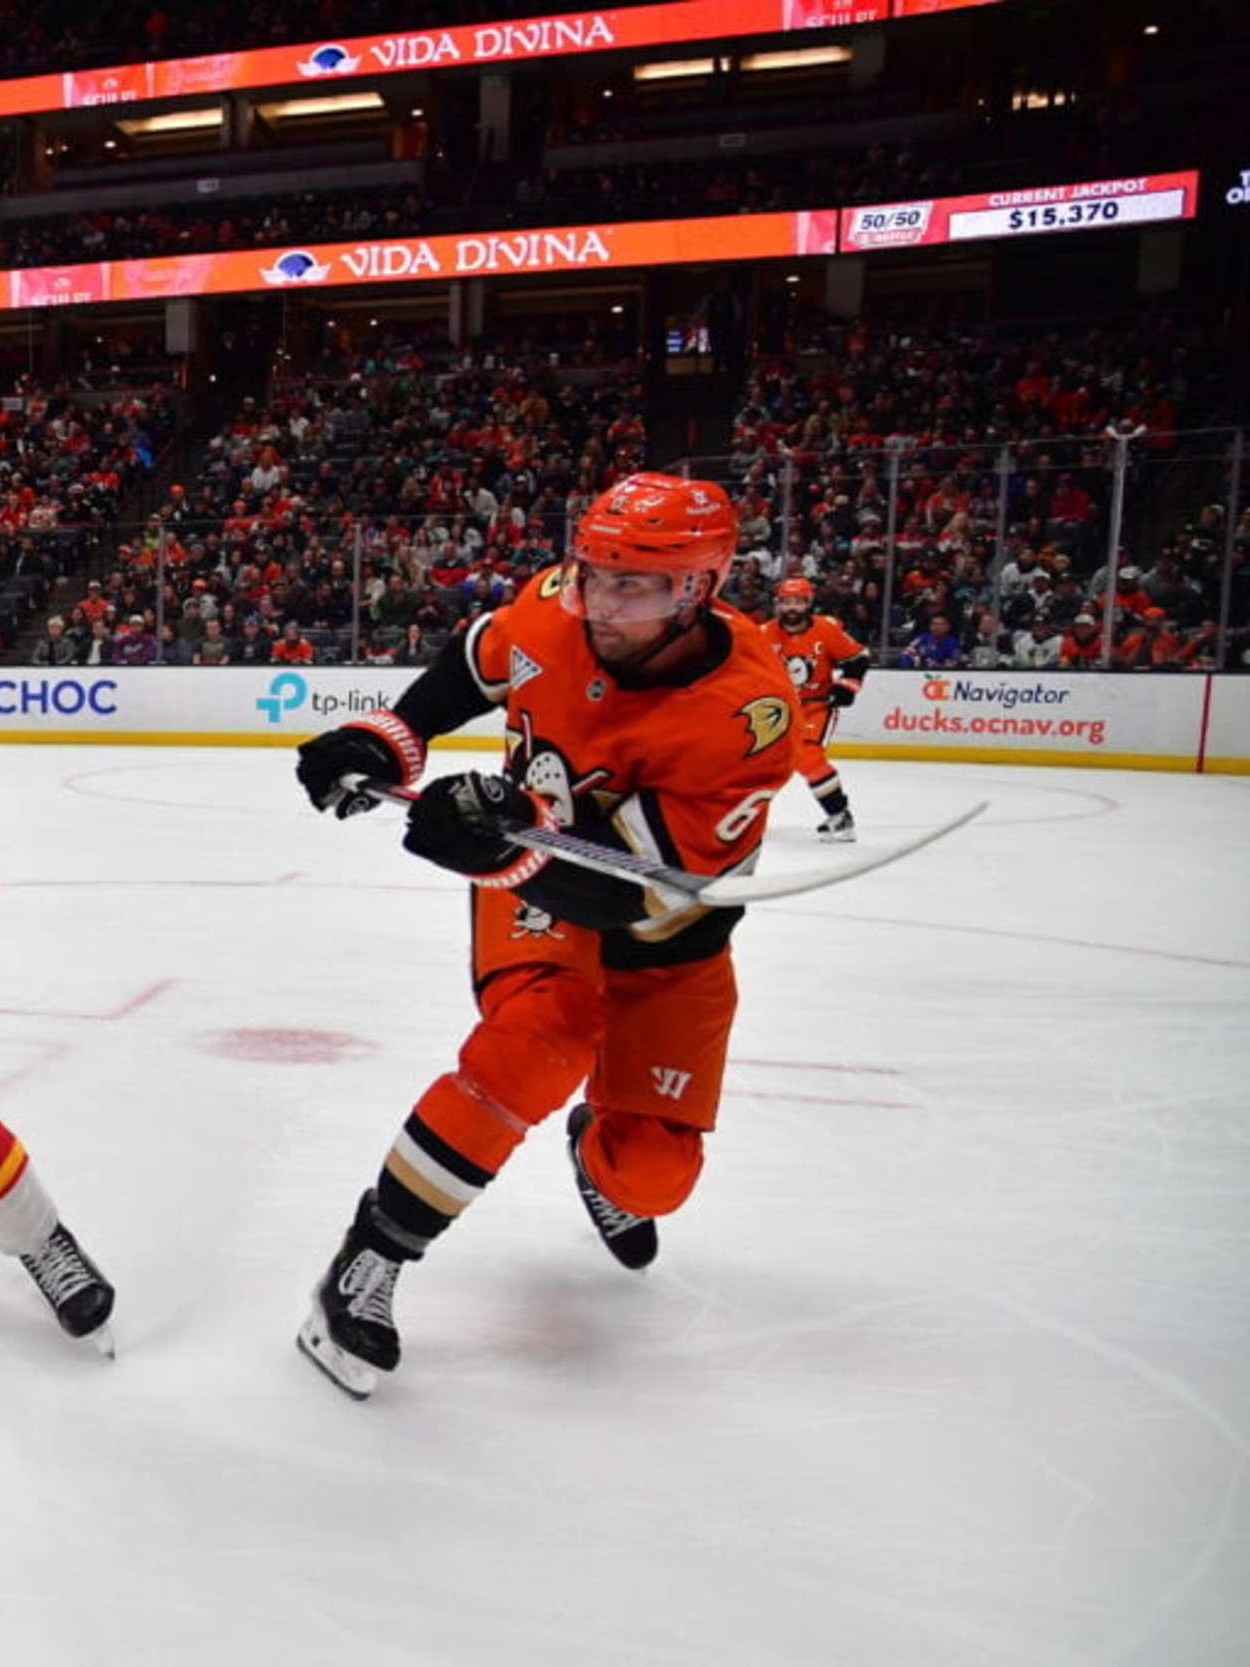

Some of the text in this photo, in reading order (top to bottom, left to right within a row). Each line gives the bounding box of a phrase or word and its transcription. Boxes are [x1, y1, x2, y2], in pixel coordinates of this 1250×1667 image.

[370, 16, 614, 67] VIDA DIVINA
[989, 178, 1149, 208] CURRENT JACKPOT
[861, 210, 921, 230] 50/50
[340, 230, 610, 277] VIDA DIVINA
[311, 688, 392, 715] tp-link
[953, 680, 1070, 709] Navigator
[883, 706, 1106, 745] ducks.ocnav.org
